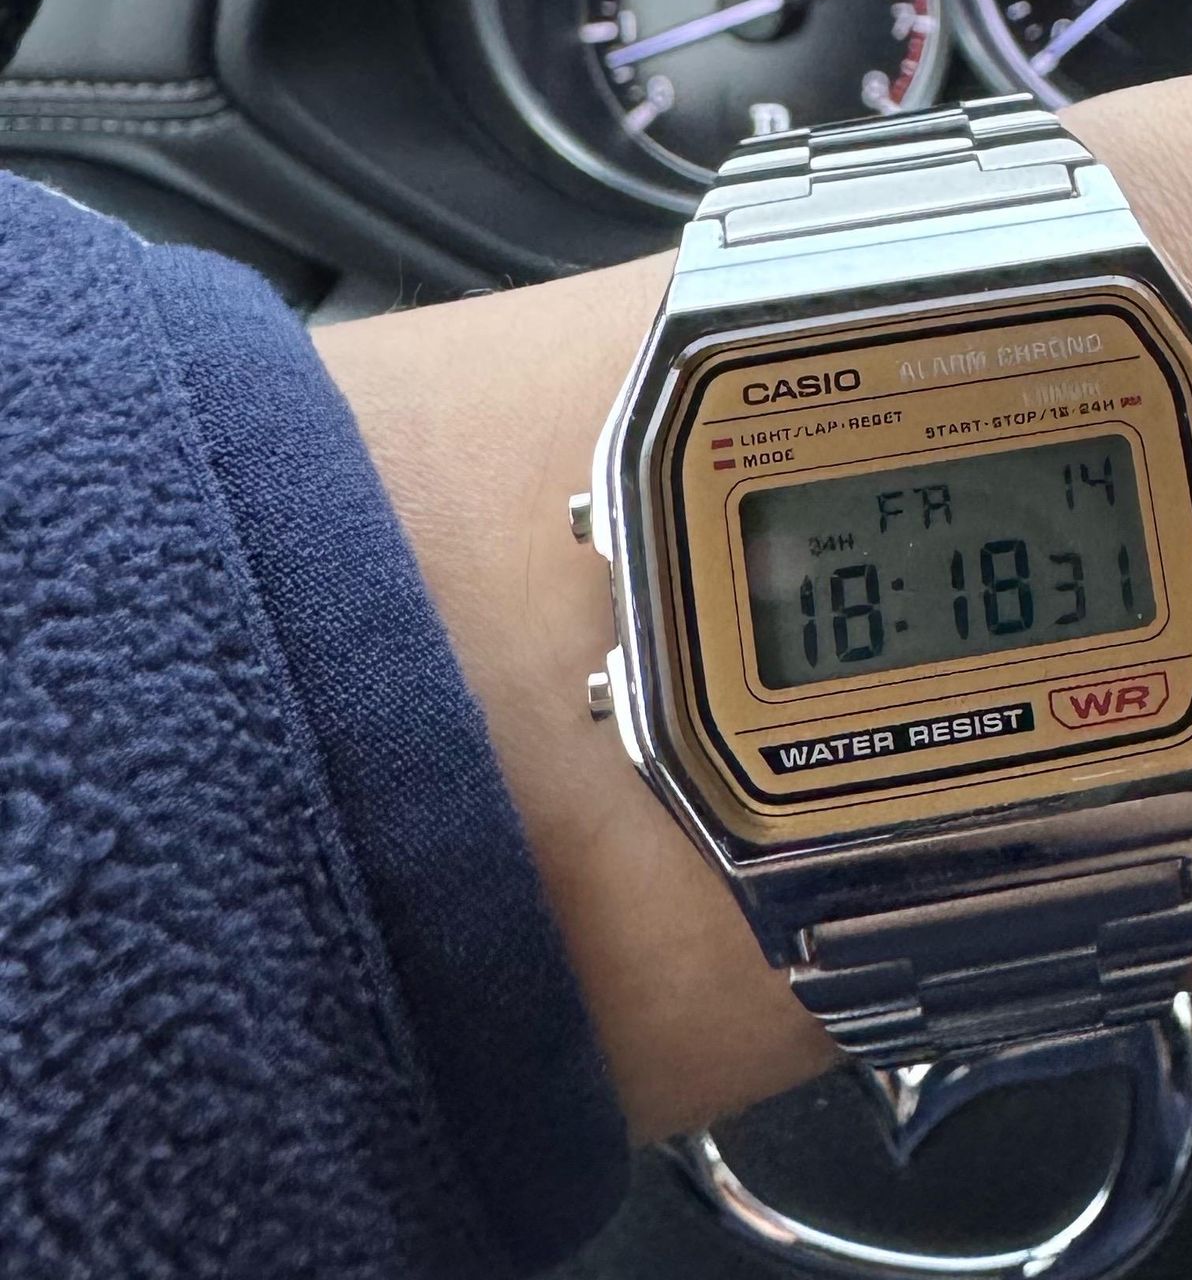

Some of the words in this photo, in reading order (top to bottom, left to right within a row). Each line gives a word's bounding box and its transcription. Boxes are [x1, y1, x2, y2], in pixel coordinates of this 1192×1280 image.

[742, 368, 861, 406] CASIO
[743, 448, 795, 469] MODE
[1063, 455, 1116, 511] 14
[1069, 685, 1151, 720] WR
[779, 730, 894, 769] WATER
[908, 708, 1025, 747] RESIST
